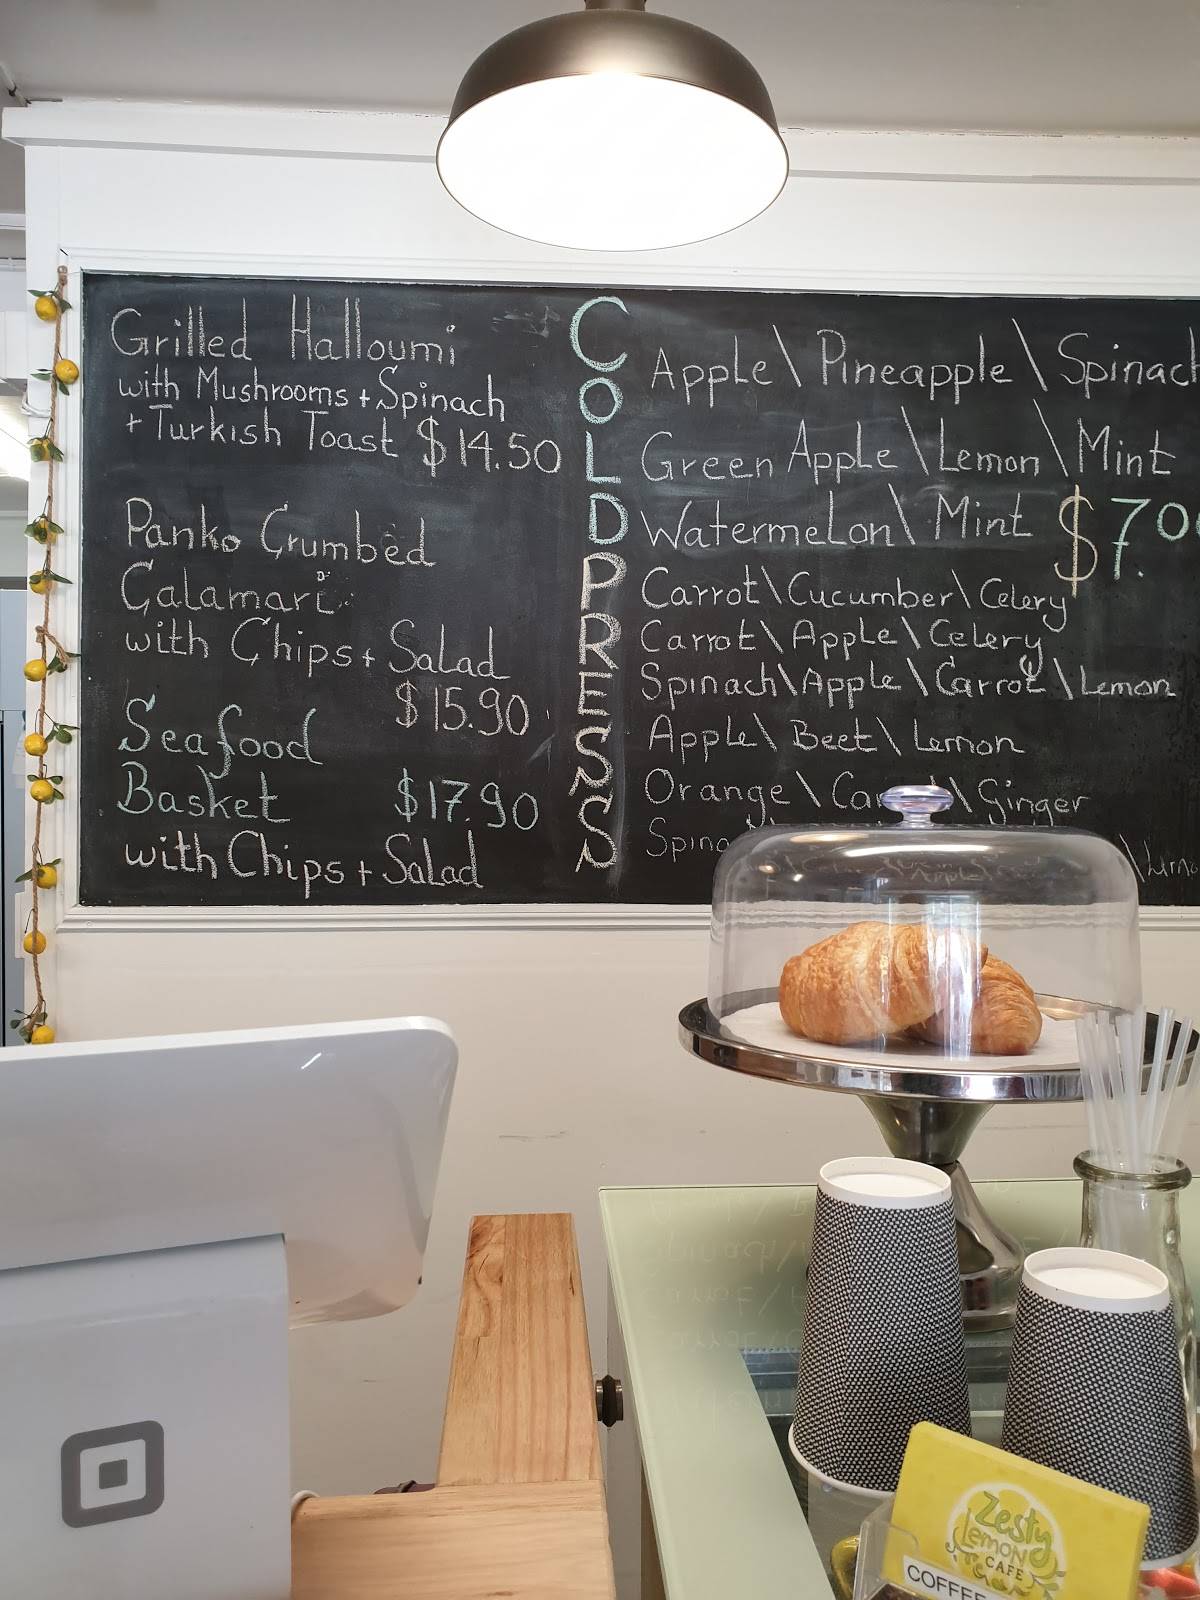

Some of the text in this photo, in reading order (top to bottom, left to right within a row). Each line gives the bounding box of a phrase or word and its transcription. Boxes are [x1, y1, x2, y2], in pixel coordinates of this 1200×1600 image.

[111, 294, 457, 366] Grilled Halloumi
[118, 363, 180, 400] with
[197, 366, 349, 407] Mushrooms
[375, 366, 505, 422] Spinach
[651, 335, 773, 408] Apple
[816, 329, 1013, 404] Pineapple
[148, 403, 281, 448] Turkish
[303, 410, 399, 458] Toast
[641, 431, 774, 481] Green
[788, 419, 898, 485] Apple
[939, 417, 1040, 477] Lemon
[1077, 417, 1176, 477] Mint
[125, 497, 436, 567] Panko Crumbed
[640, 491, 895, 549] Watermelon
[935, 492, 1034, 541] Mint
[120, 560, 335, 616] Calamari
[641, 564, 760, 609] Carrot
[788, 571, 953, 609] Cucumber
[979, 578, 1067, 633] Celery
[126, 617, 208, 658] with
[231, 616, 353, 678] Chips
[388, 619, 510, 680] Salad
[640, 618, 757, 653] Carrot
[792, 616, 898, 660] Apple
[929, 618, 1043, 679] Celery
[395, 679, 530, 737] $15.90
[640, 661, 777, 711] Spinach
[802, 660, 901, 710] Apple
[1080, 665, 1176, 697] Lemon
[118, 694, 323, 779] Seafood
[649, 713, 758, 765] Apple
[790, 717, 878, 753] Beet
[914, 718, 1025, 756] Lemon
[117, 761, 539, 830] Basket $17.90
[645, 767, 791, 831] Orange
[978, 777, 1091, 827] Ginger
[125, 830, 218, 880] with
[228, 830, 345, 899] Chips
[382, 830, 483, 889] Salad
[975, 1491, 1051, 1568] Zesty
[985, 1556, 1024, 1581] CAFE
